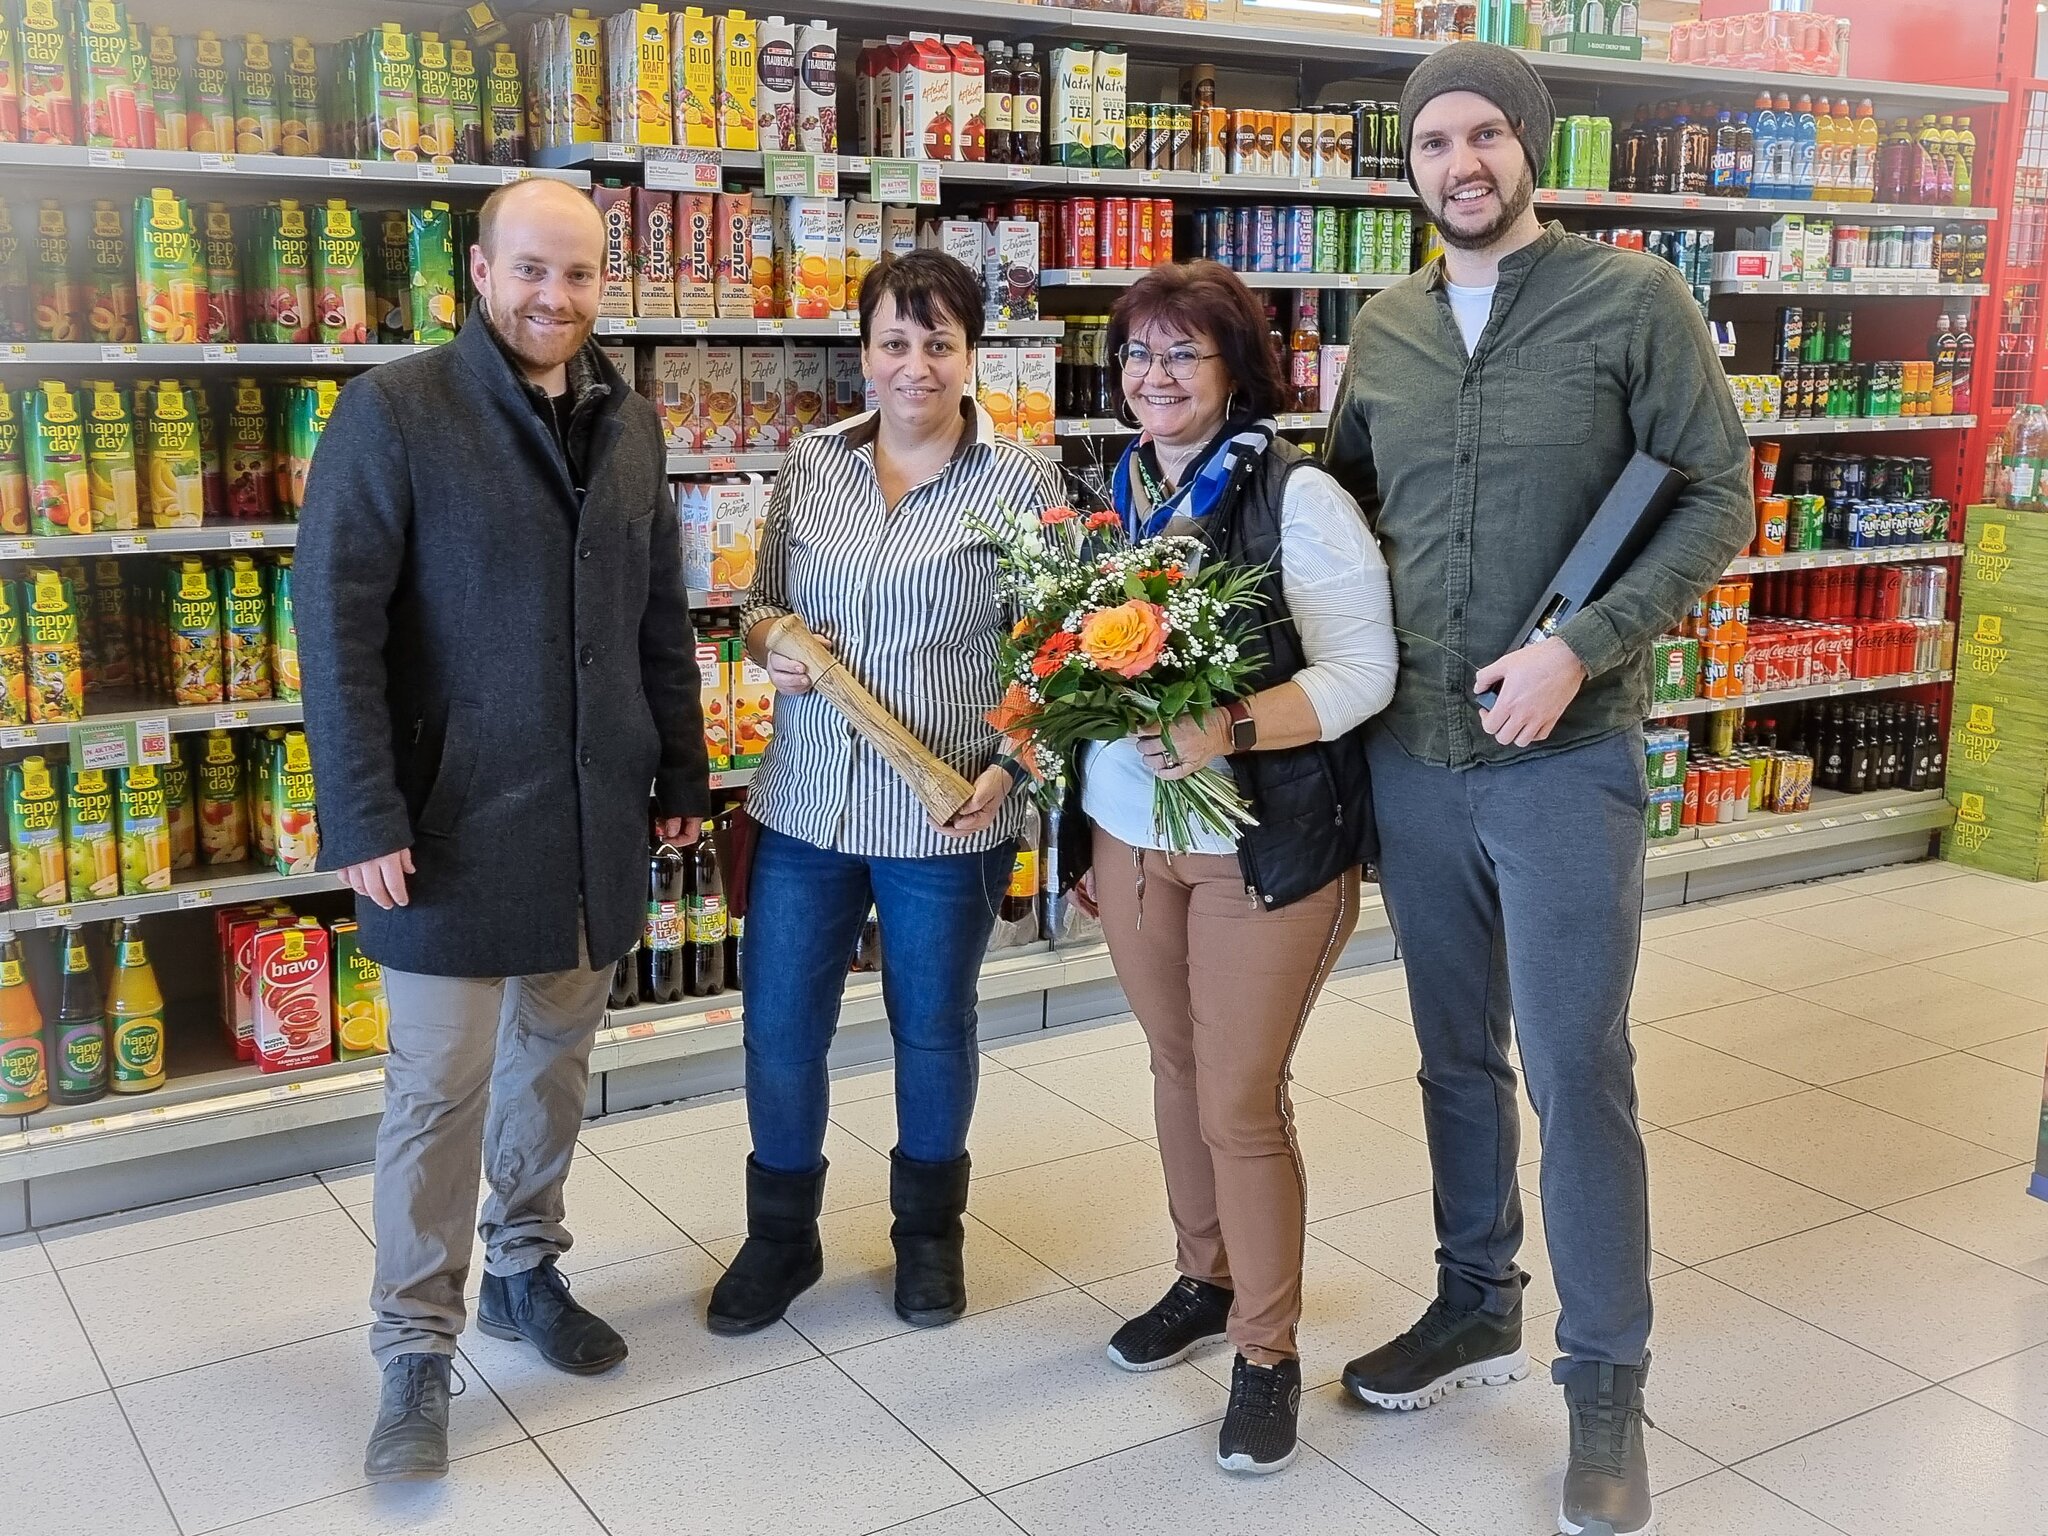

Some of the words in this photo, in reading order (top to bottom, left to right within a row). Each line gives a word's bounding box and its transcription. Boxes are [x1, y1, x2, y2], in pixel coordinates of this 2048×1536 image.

[31, 19, 55, 27] RAUCH
[17, 27, 64, 49] happy
[80, 32, 127, 53] happy
[27, 44, 60, 64] day
[90, 48, 120, 67] day
[575, 48, 597, 66] BIO
[643, 45, 664, 61] BIO
[690, 48, 711, 64] BIO
[730, 51, 752, 67] BIO
[190, 65, 228, 84] happy
[374, 60, 414, 80] happy
[575, 65, 597, 78] KRAFT
[643, 62, 664, 74] KRAFT
[238, 68, 276, 86] happy
[383, 75, 409, 91] day
[450, 77, 479, 93] appy
[1062, 73, 1092, 90] Nativ
[1095, 75, 1126, 93] Nativ
[152, 78, 177, 93] day
[199, 81, 225, 97] day
[247, 83, 272, 99] day
[422, 82, 447, 98] day
[487, 78, 522, 95] happy
[292, 86, 317, 102] day
[452, 88, 476, 104] day
[495, 89, 521, 106] day
[1070, 106, 1091, 119] TEA
[1103, 108, 1125, 120] TEA
[1128, 118, 1147, 127] JACO
[1171, 119, 1193, 128] ACOBS
[1711, 152, 1735, 168] RACE
[1740, 154, 1753, 169] RA
[696, 168, 717, 180] 2.49
[159, 218, 180, 226] RAUCH
[333, 227, 352, 235] RAUCH
[853, 223, 881, 239] Orange
[1078, 228, 1095, 237] CAN
[33, 236, 71, 252] happy
[88, 236, 126, 252] happy
[143, 229, 189, 250] happy
[318, 237, 360, 253] happy
[608, 212, 623, 275] ZUEGG
[652, 213, 666, 277] ZUEGG
[693, 215, 707, 280] ZUEGG
[154, 244, 184, 262] day
[732, 217, 747, 282] ZUEGG
[41, 251, 67, 266] day
[97, 251, 123, 267] day
[208, 253, 234, 269] day
[282, 251, 308, 268] day
[328, 252, 356, 269] day
[665, 360, 690, 379] Apfel
[708, 360, 733, 380] Apfel
[752, 360, 776, 379] Apfel
[794, 360, 819, 379] Apfel
[53, 411, 75, 420] RAUCH
[99, 410, 121, 418] RAUCH
[163, 409, 185, 418] RAUCH
[37, 422, 81, 441] happy
[85, 420, 130, 439] happy
[150, 420, 194, 438] happy
[238, 427, 264, 443] day
[49, 436, 78, 454] day
[95, 435, 124, 452] day
[159, 435, 187, 452] day
[716, 501, 750, 520] Orange
[1765, 523, 1786, 538] FAN
[1859, 520, 1876, 532] FAN
[1876, 519, 1891, 531] FAN
[1892, 519, 1907, 531] FAN
[1909, 518, 1924, 530] FAN
[1970, 550, 2011, 572] happy
[1976, 566, 2002, 585] day
[186, 590, 208, 598] RAUCH
[238, 588, 260, 596] RAUCH
[41, 601, 64, 609] RAUCH
[172, 599, 216, 617] happy
[225, 598, 266, 615] happy
[26, 613, 74, 629] happy
[182, 614, 210, 629] day
[235, 611, 262, 628] day
[1709, 606, 1733, 623] FANT
[36, 627, 66, 644] day
[1965, 641, 2008, 664] happy
[1972, 657, 1998, 676] day
[1957, 730, 2001, 754] happy
[1965, 747, 1991, 765] day
[200, 764, 240, 781] happy
[81, 784, 104, 793] RAUCH
[132, 779, 155, 788] RAUCH
[209, 776, 236, 794] day
[278, 772, 314, 790] happ
[28, 788, 51, 798] RAUCH
[120, 788, 164, 807] happy
[287, 786, 314, 802] day
[13, 800, 59, 818] happy
[67, 794, 112, 811] happy
[77, 808, 107, 825] day
[129, 803, 158, 820] day
[24, 814, 53, 830] day
[1956, 834, 1982, 853] day
[658, 920, 675, 930] ICE
[702, 913, 718, 923] ICE
[657, 929, 676, 939] TEA
[701, 922, 720, 932] TEA
[271, 958, 319, 978] bravo
[359, 968, 382, 981] day
[68, 1039, 103, 1054] happy
[123, 1031, 158, 1047] happy
[76, 1052, 99, 1065] day
[131, 1044, 154, 1057] day
[1, 1052, 39, 1068] happy
[10, 1065, 35, 1078] day
